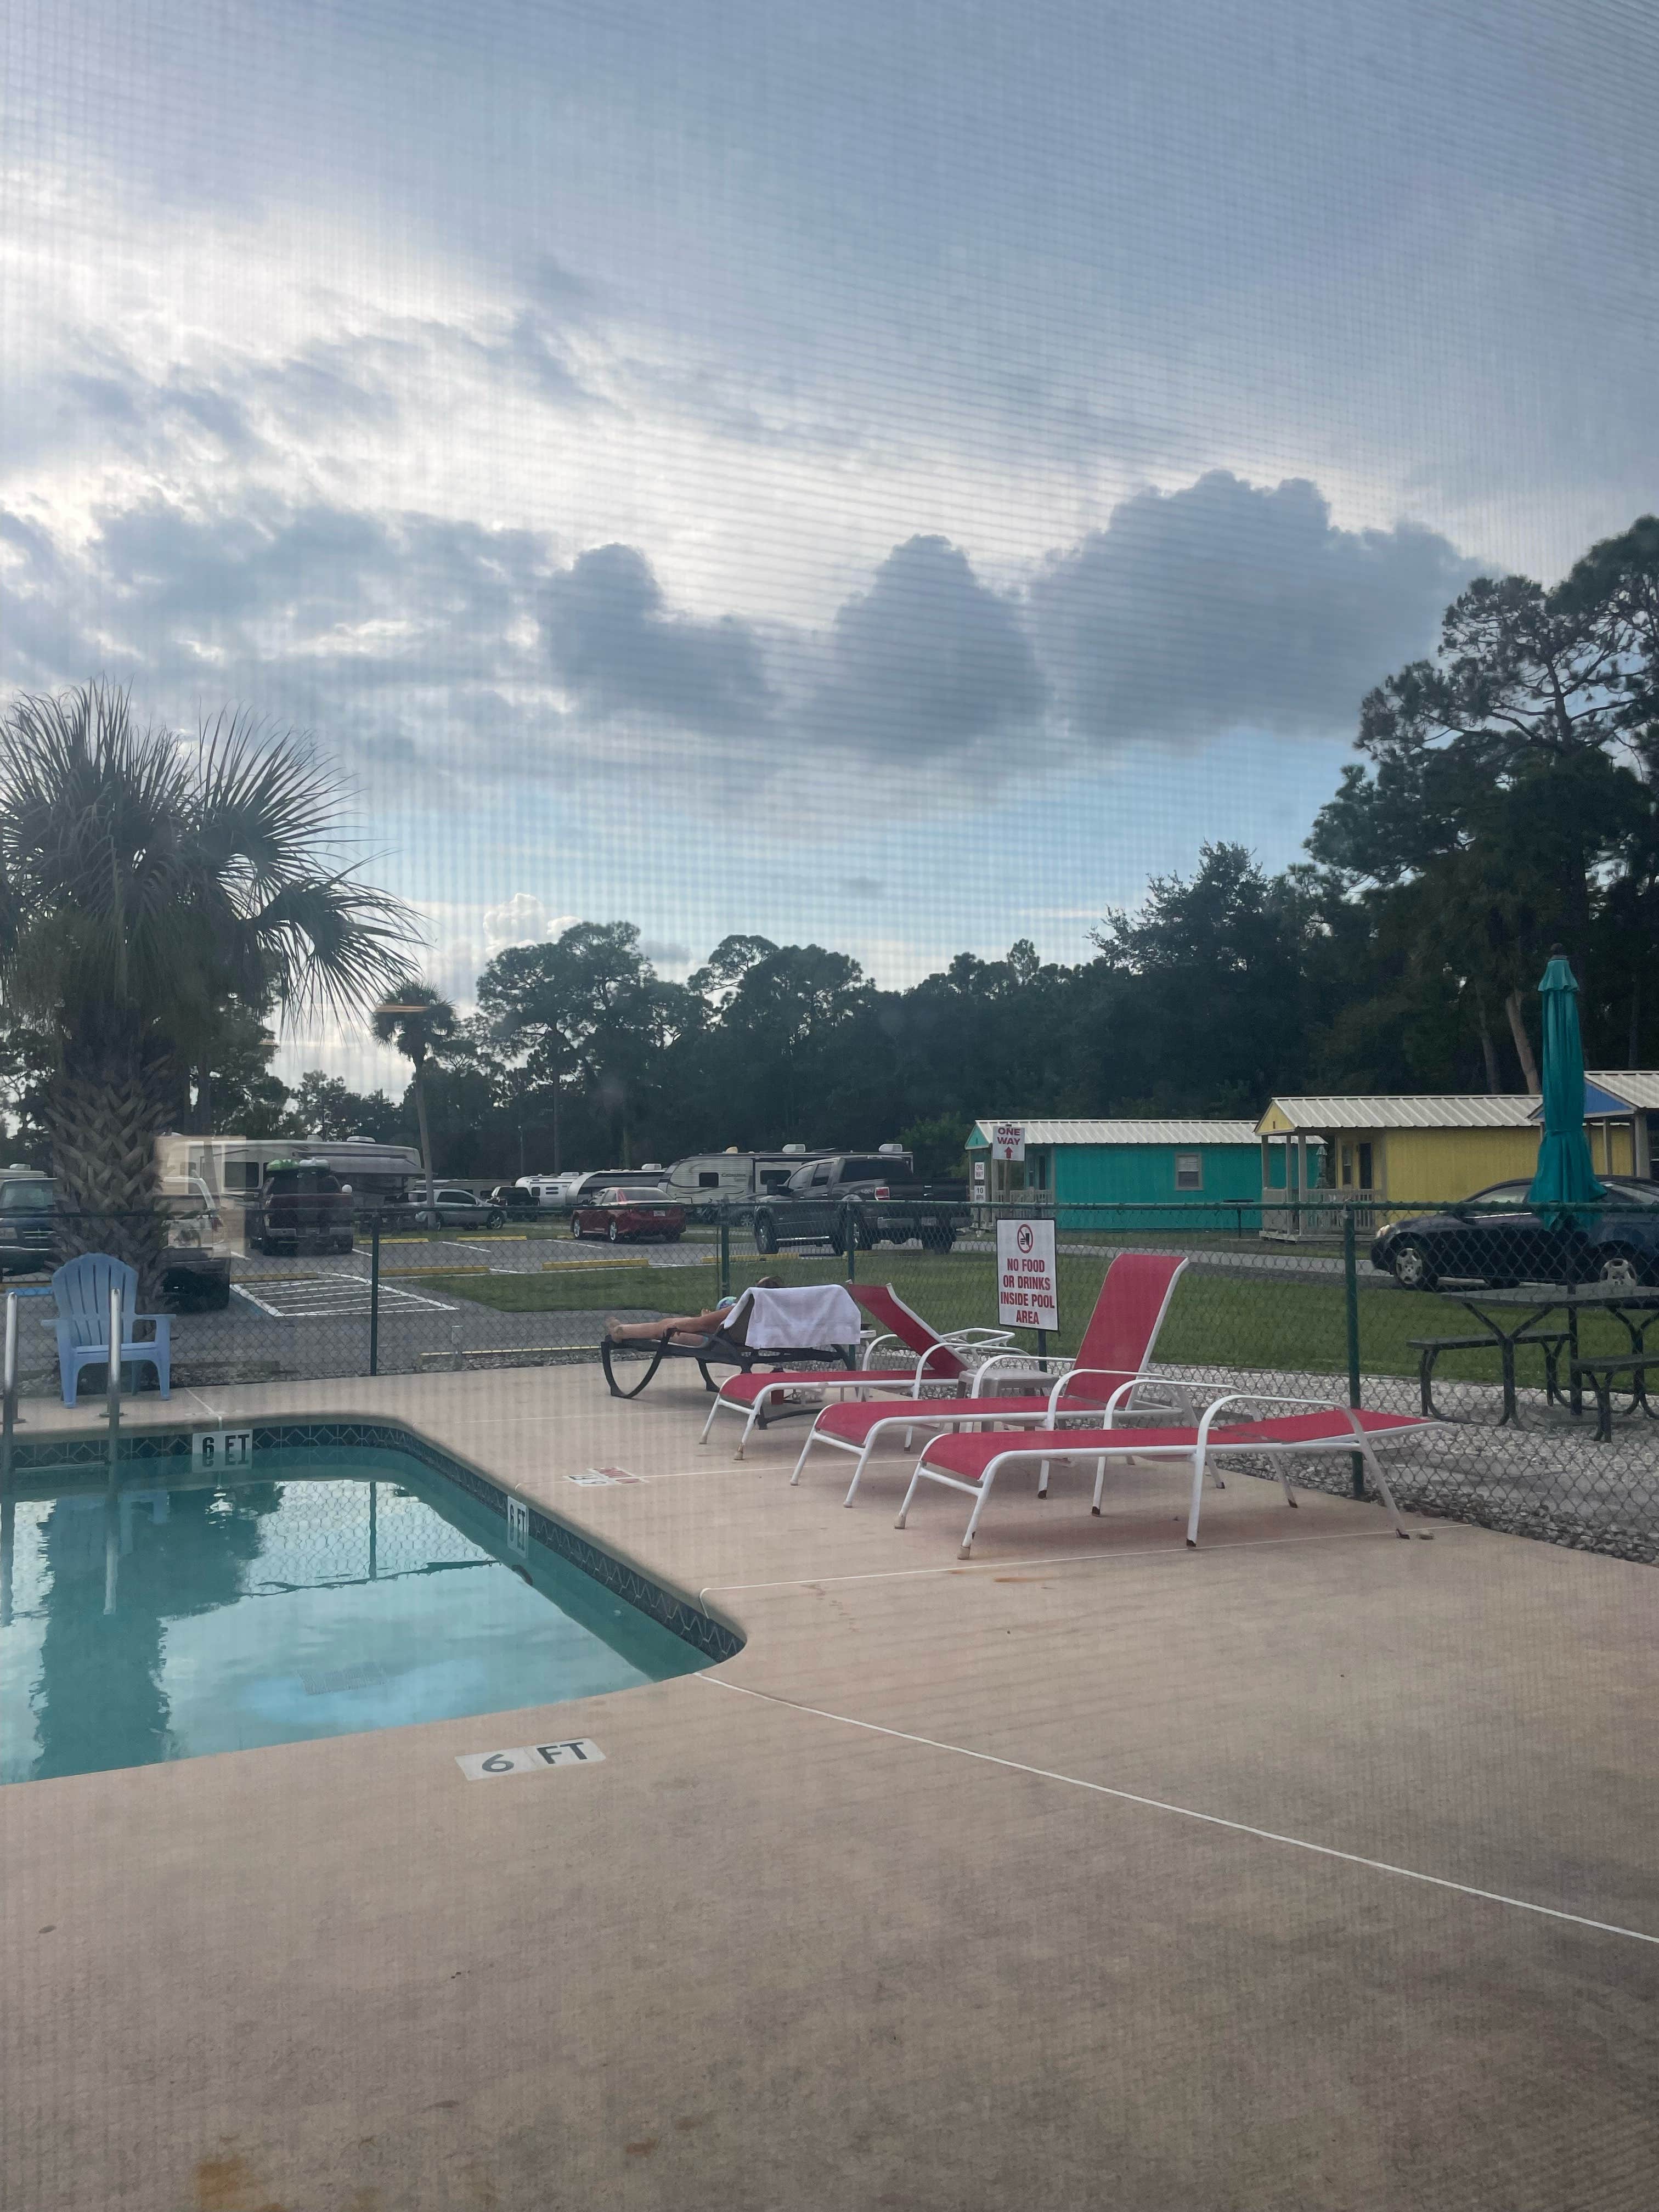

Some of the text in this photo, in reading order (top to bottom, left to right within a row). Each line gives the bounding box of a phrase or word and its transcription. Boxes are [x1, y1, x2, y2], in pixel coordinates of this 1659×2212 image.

[998, 1127, 1020, 1136] ONE
[997, 1137, 1020, 1145] WAY
[1007, 1258, 1045, 1273] NO FOOD
[1003, 1275, 1051, 1291] OR DRINKS
[1001, 1291, 1055, 1308] INSIDE POOL
[1016, 1310, 1040, 1324] AREA
[202, 1434, 250, 1454] 6 FT
[482, 1742, 588, 1773] 6 FT
